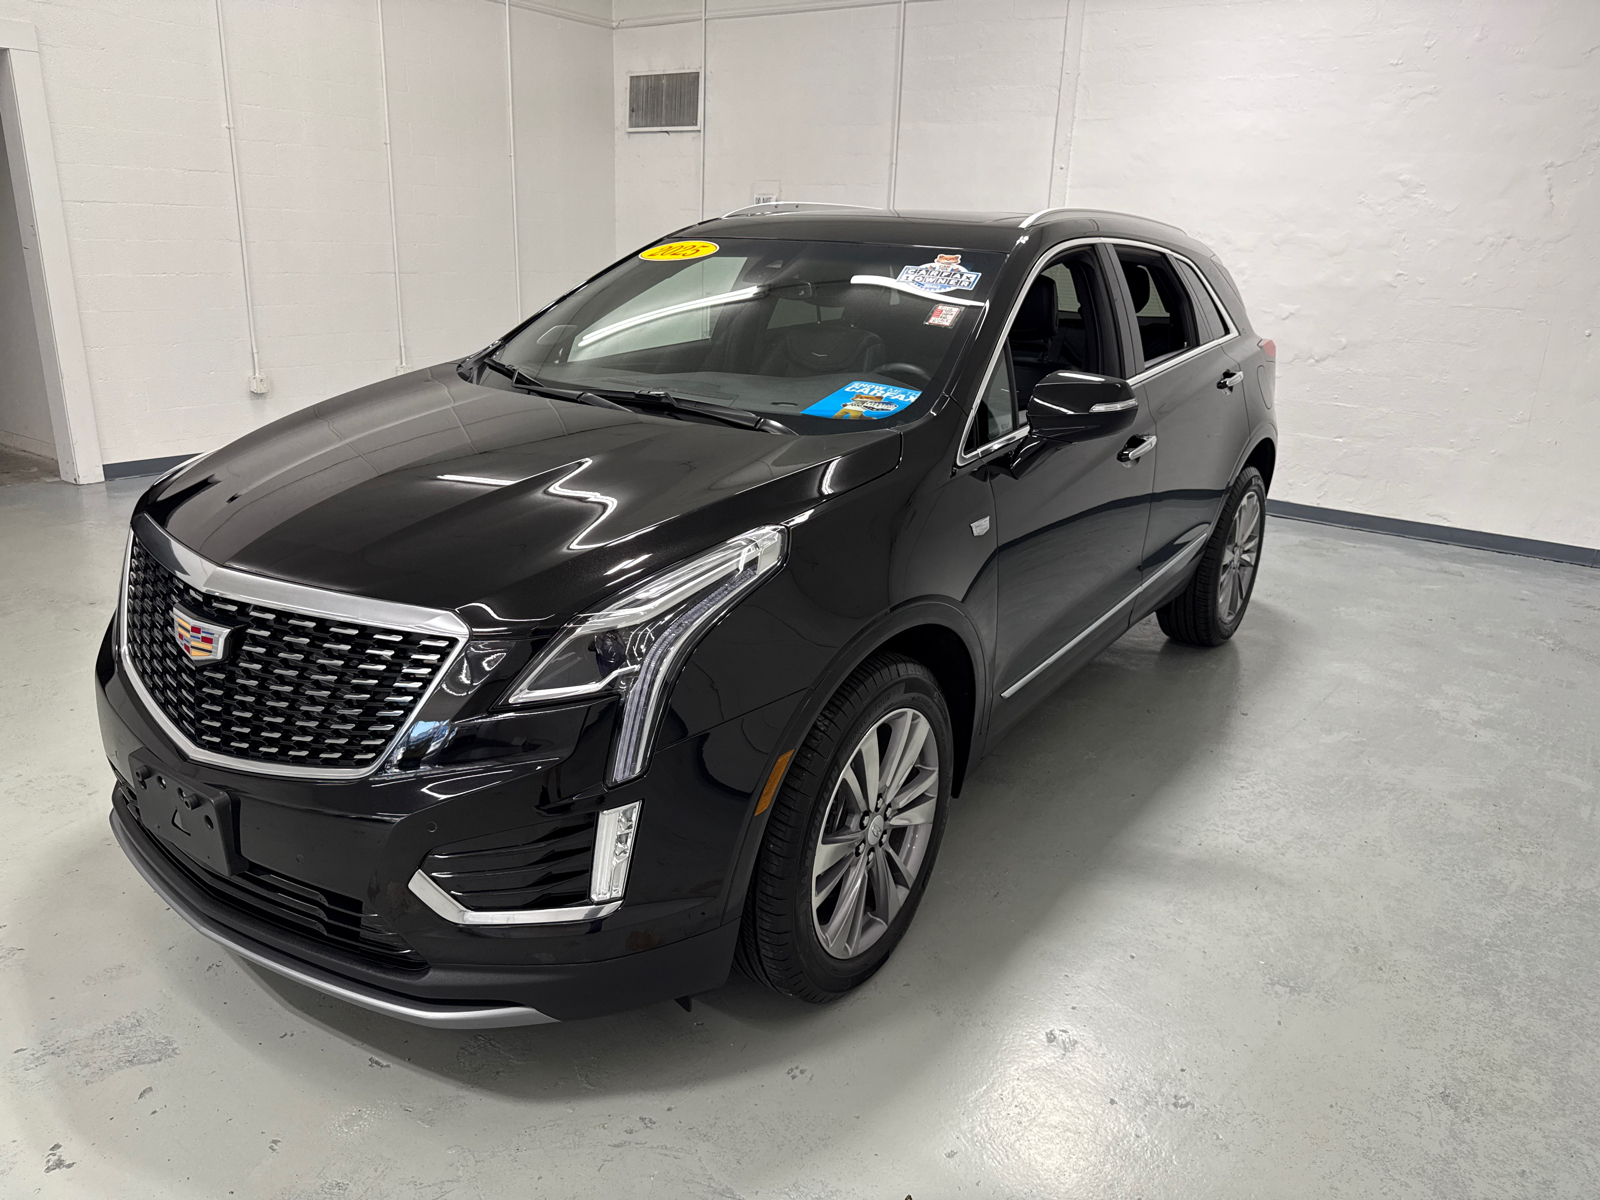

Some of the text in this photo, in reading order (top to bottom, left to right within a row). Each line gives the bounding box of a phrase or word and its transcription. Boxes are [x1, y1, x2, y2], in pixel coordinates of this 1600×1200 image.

[647, 244, 710, 258] 2025
[905, 268, 973, 281] CARFAX
[912, 275, 972, 288] OWNER
[852, 382, 887, 391] SHOW
[844, 385, 917, 403] CARFAX
[874, 692, 892, 713] TOUR
[805, 765, 839, 868] MICHELIN
